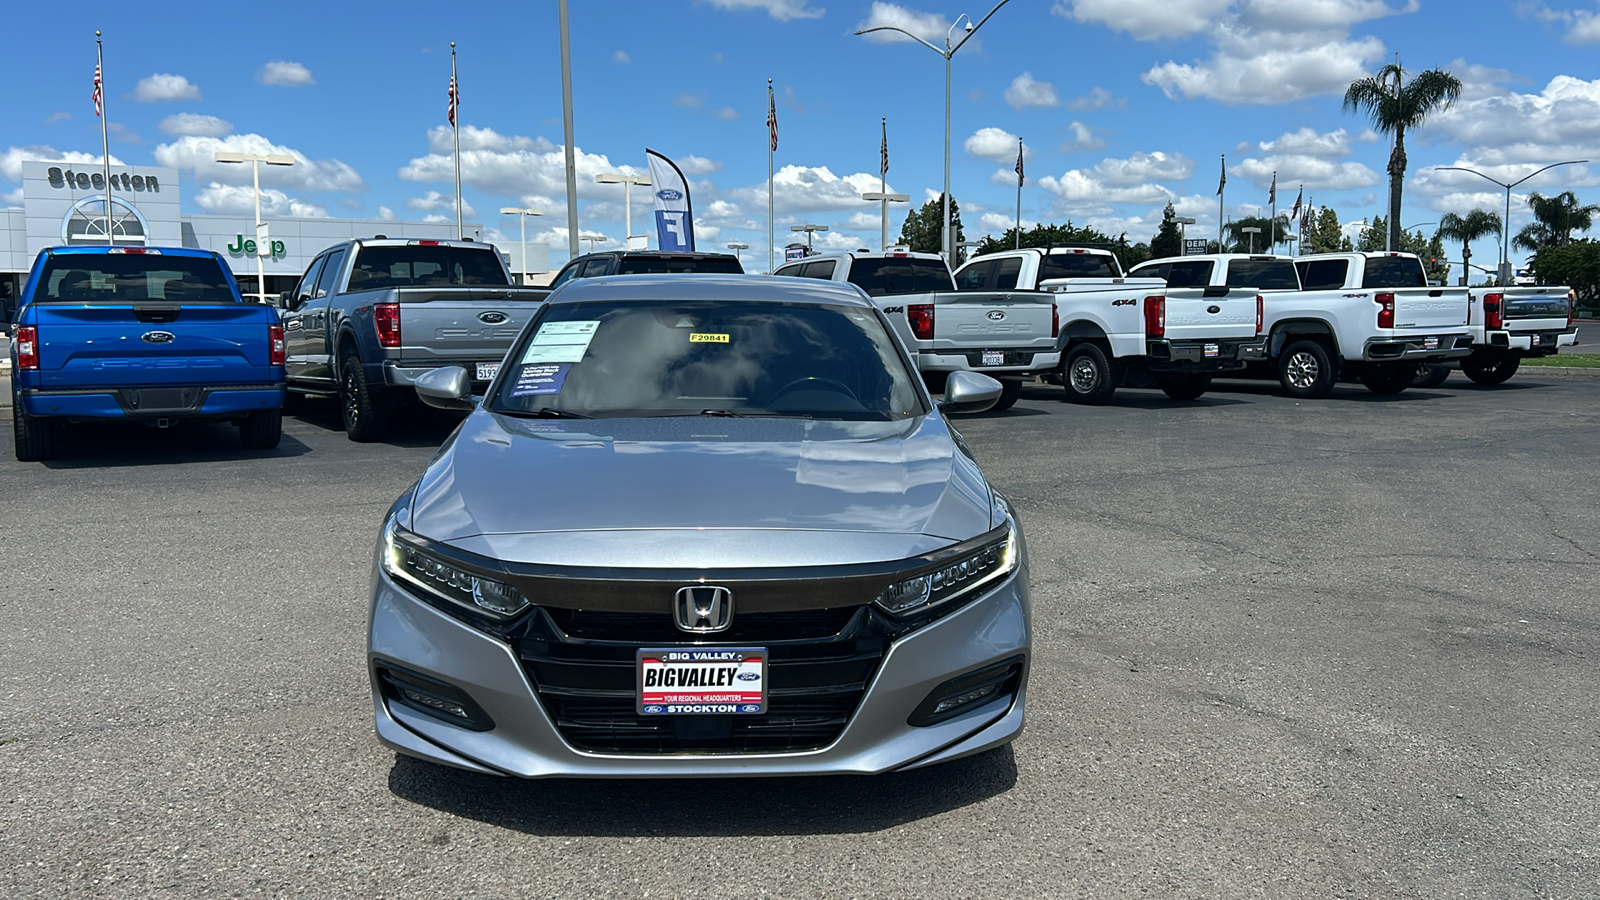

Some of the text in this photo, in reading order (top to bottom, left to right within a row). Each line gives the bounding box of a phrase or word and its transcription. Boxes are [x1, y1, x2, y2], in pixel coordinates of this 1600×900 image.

[47, 167, 160, 190] Stockton
[227, 234, 285, 257] Jep
[1186, 240, 1206, 248] OEM
[1400, 302, 1465, 311] CHEVROLET
[956, 322, 1034, 334] F-150
[434, 327, 521, 339] F-15
[692, 334, 726, 342] F29841
[669, 652, 736, 660] BIG VALLEY
[645, 667, 738, 687] BIGVALLEY
[703, 694, 742, 702] HEADQUARTERS
[667, 704, 737, 713] STOCKTON
